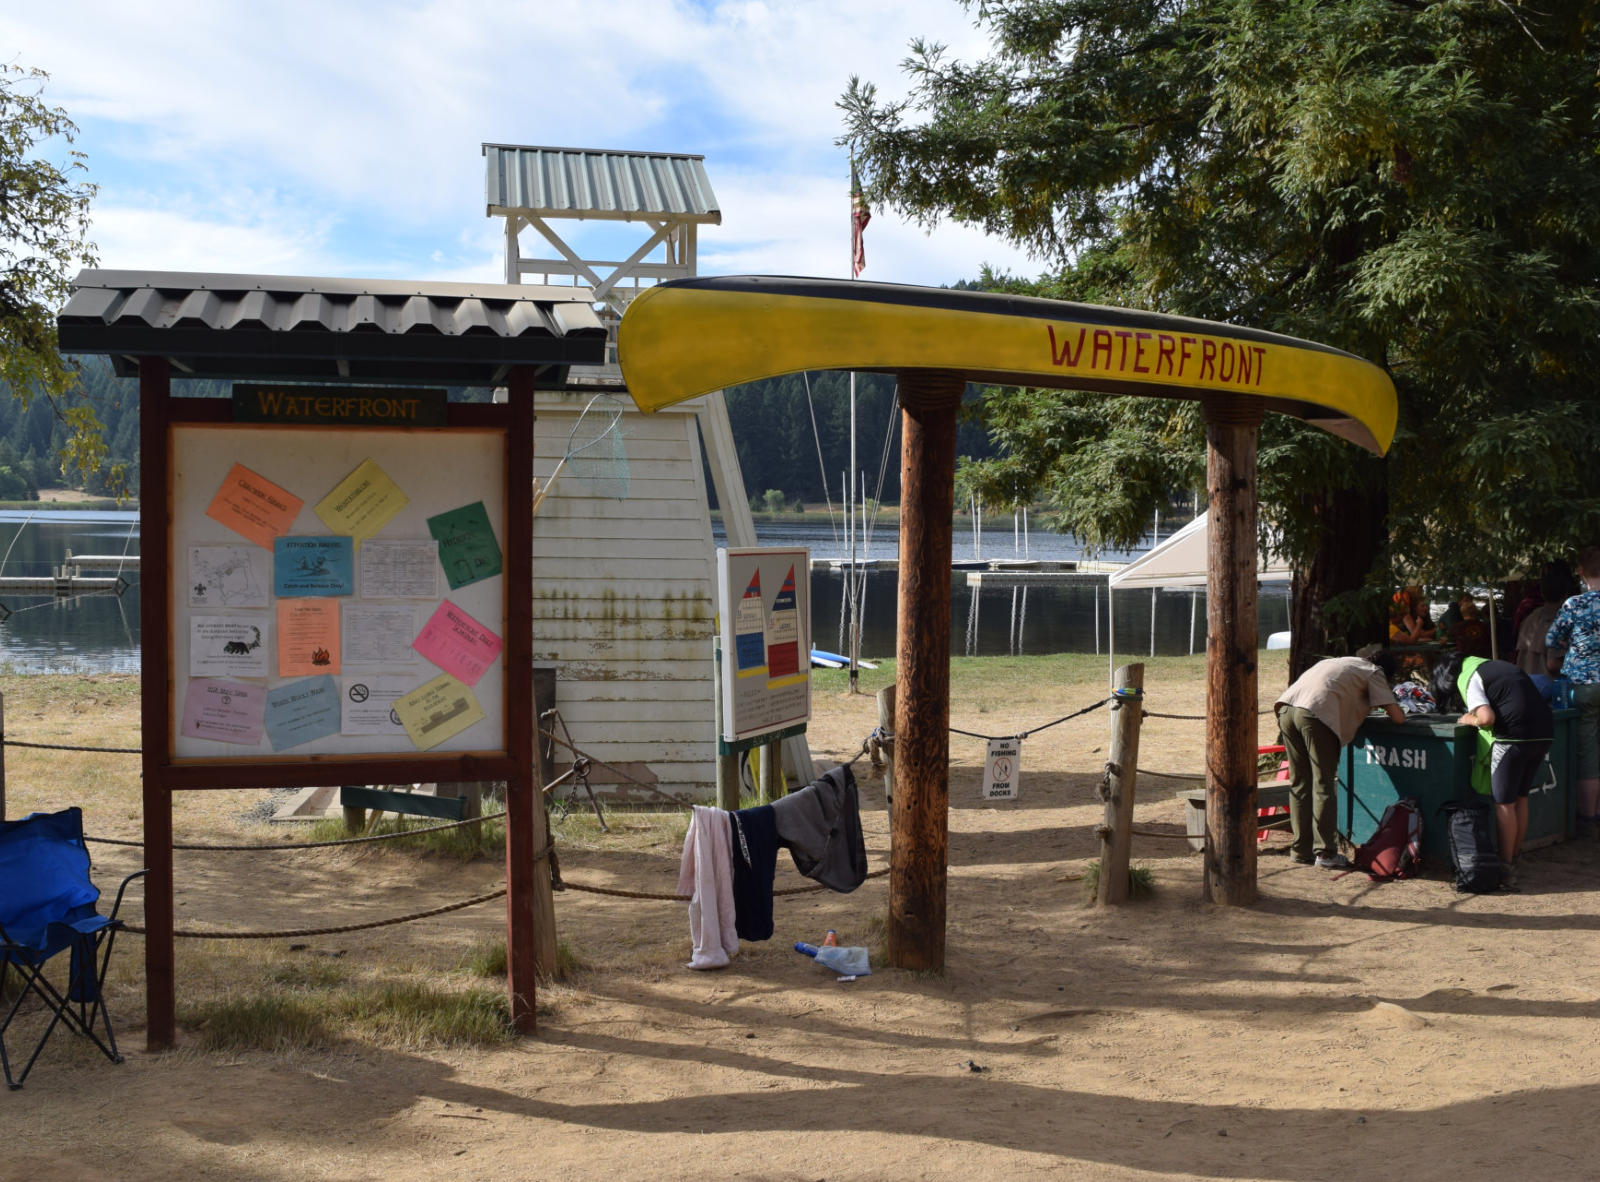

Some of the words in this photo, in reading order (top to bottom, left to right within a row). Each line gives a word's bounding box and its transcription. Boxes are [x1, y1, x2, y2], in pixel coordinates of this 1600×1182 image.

[1047, 325, 1266, 386] WATERFRONT
[257, 390, 422, 420] WATERFRONT
[1364, 744, 1426, 769] TRASH
